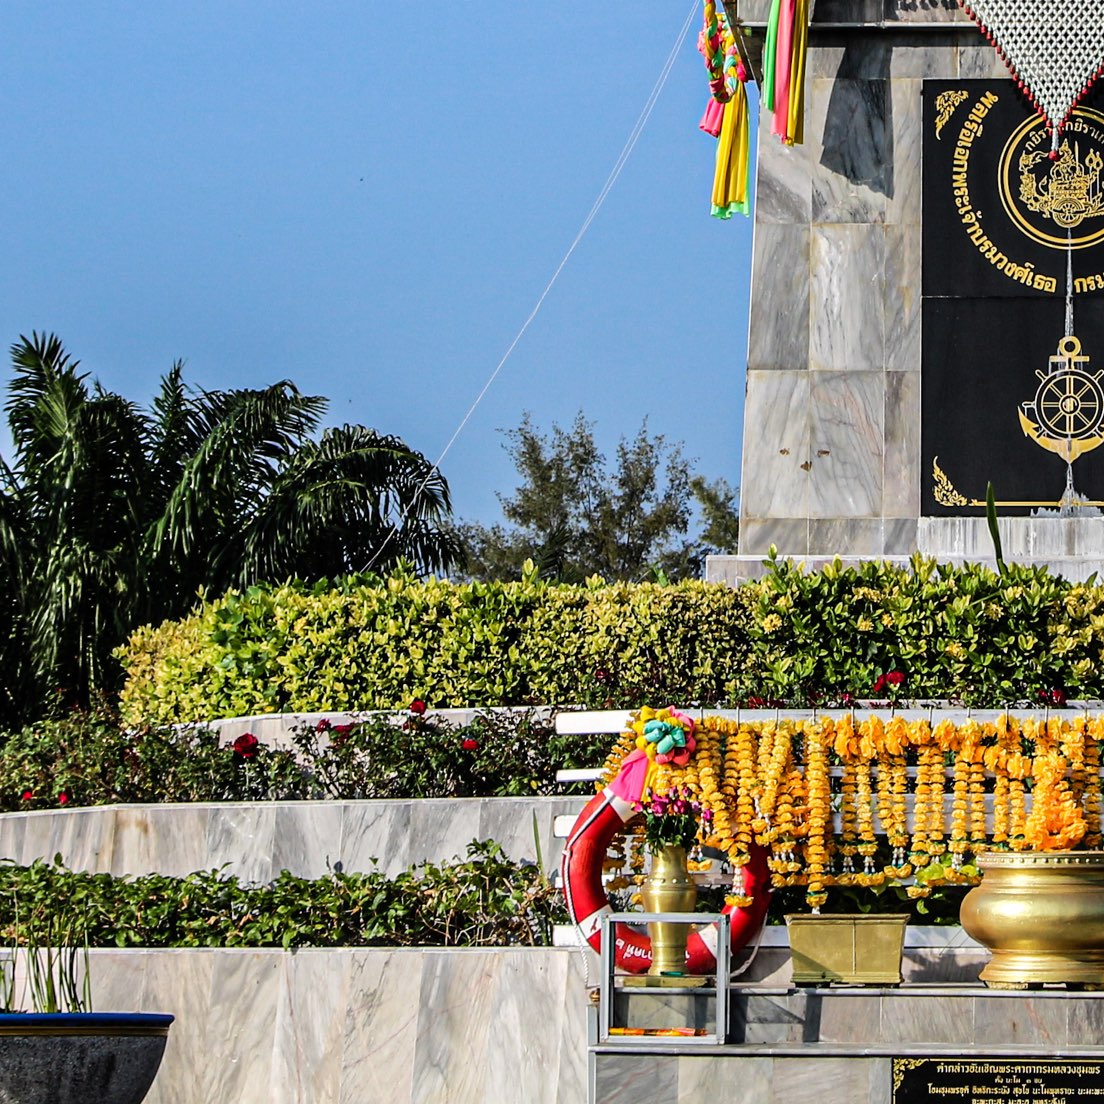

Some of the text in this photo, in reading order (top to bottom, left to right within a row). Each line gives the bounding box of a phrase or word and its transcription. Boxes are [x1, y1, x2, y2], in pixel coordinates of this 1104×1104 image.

[952, 90, 1057, 293] พลเรือเอกพระเจ้าบรมวงศ์เธอ
